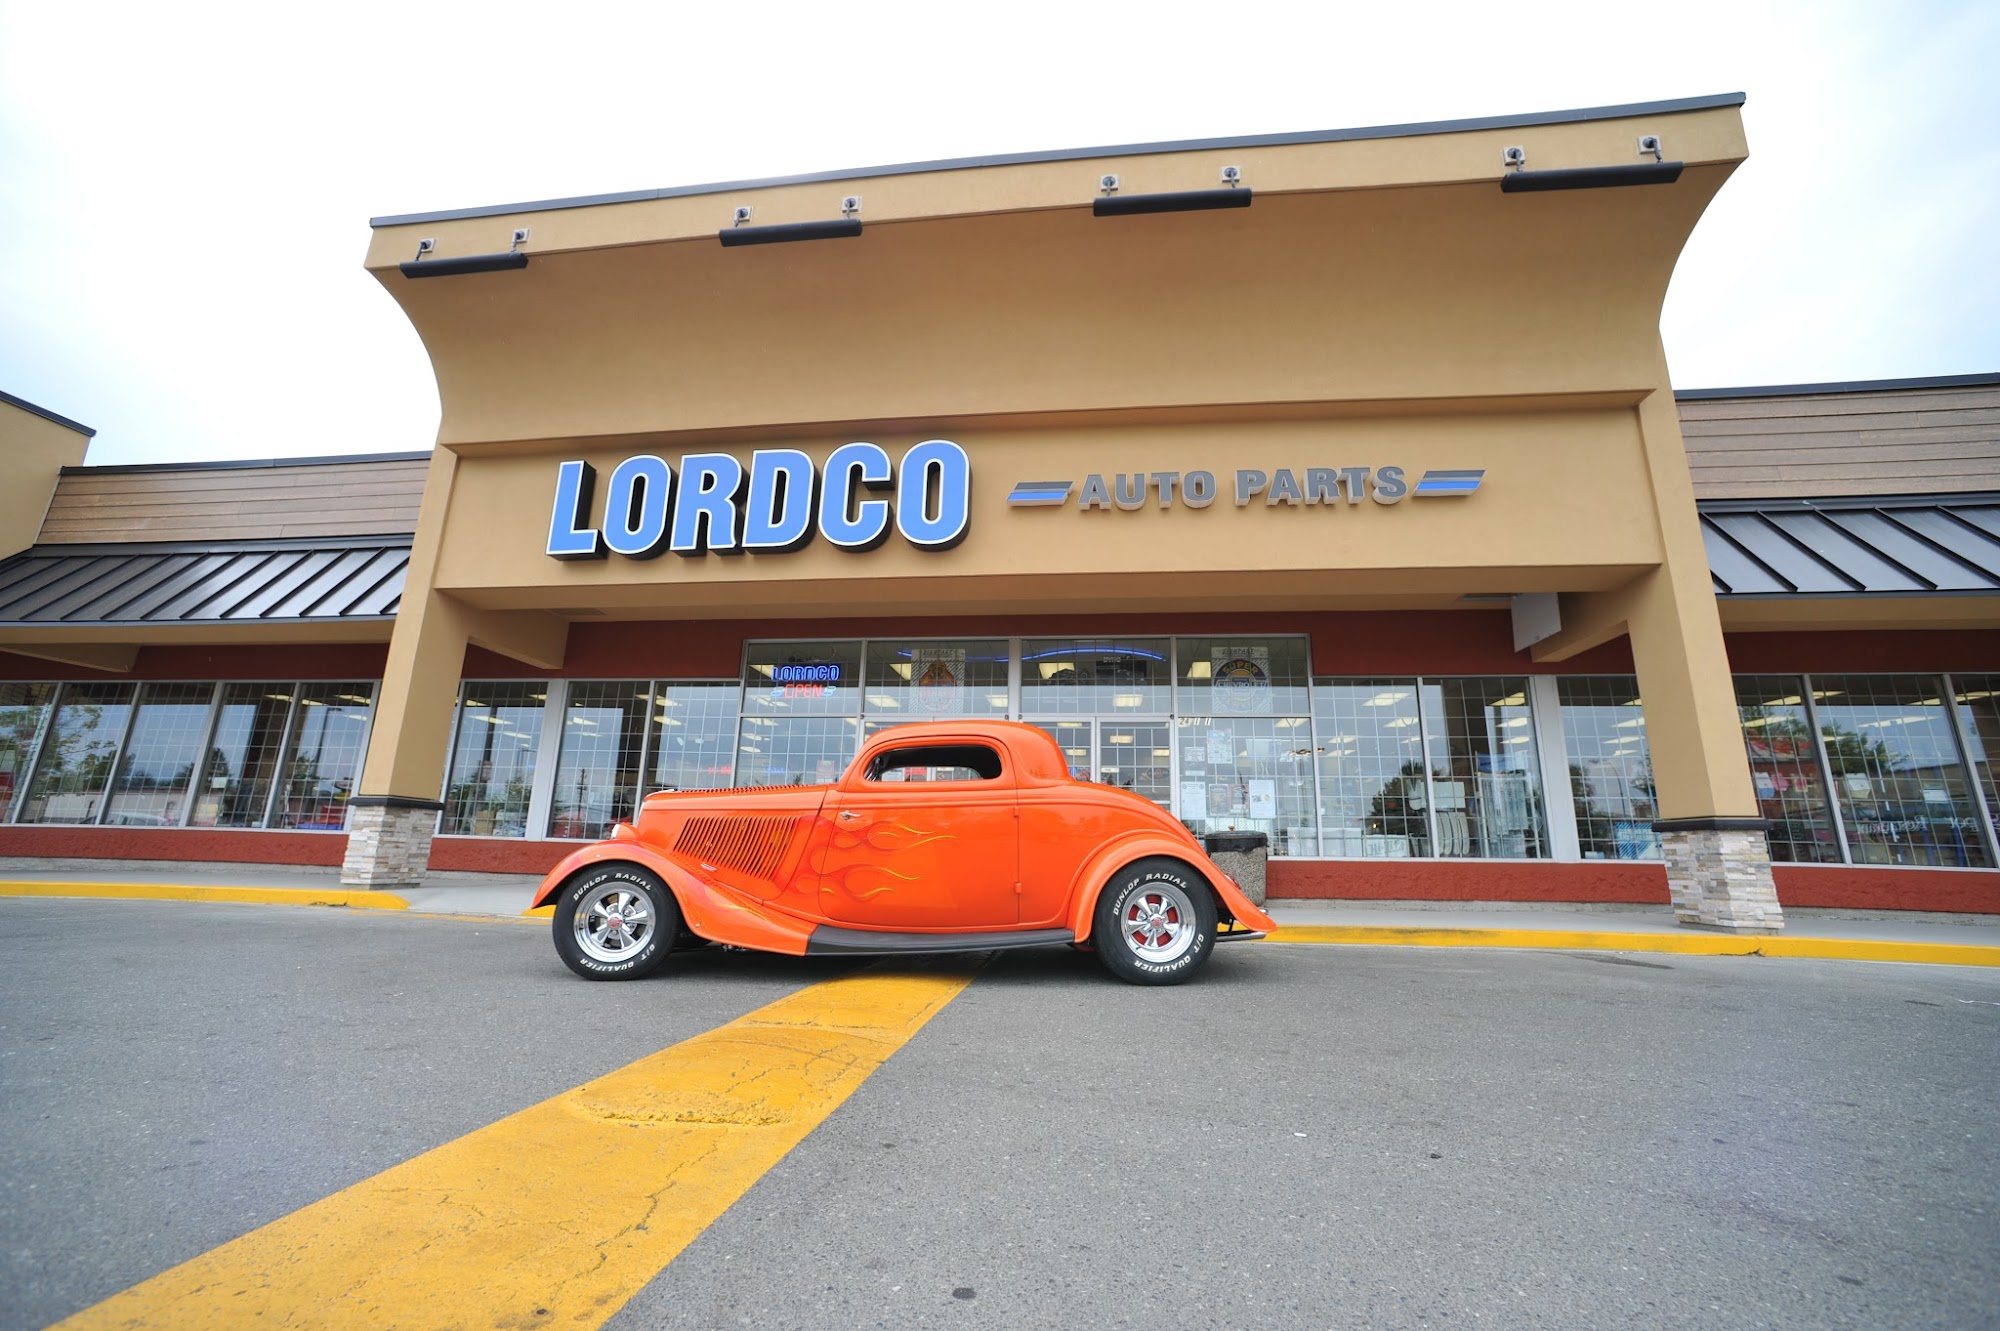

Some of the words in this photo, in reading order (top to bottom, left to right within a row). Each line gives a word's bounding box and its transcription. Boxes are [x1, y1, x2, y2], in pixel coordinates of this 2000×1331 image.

[545, 438, 971, 557] LORDCO
[1078, 470, 1216, 510] AUTO
[1234, 467, 1408, 507] PARTS
[771, 665, 840, 682] LORDCO
[1222, 661, 1259, 674] SUPER
[573, 874, 608, 901] DUNLOP
[615, 872, 652, 891] RADIAL
[1113, 878, 1140, 916] DUNLOP
[1145, 873, 1187, 889] RADIAL
[640, 943, 656, 960] G/T
[1193, 933, 1205, 953] G/T
[580, 958, 635, 972] QUALIFIER
[1134, 955, 1191, 973] QUALIFIER
